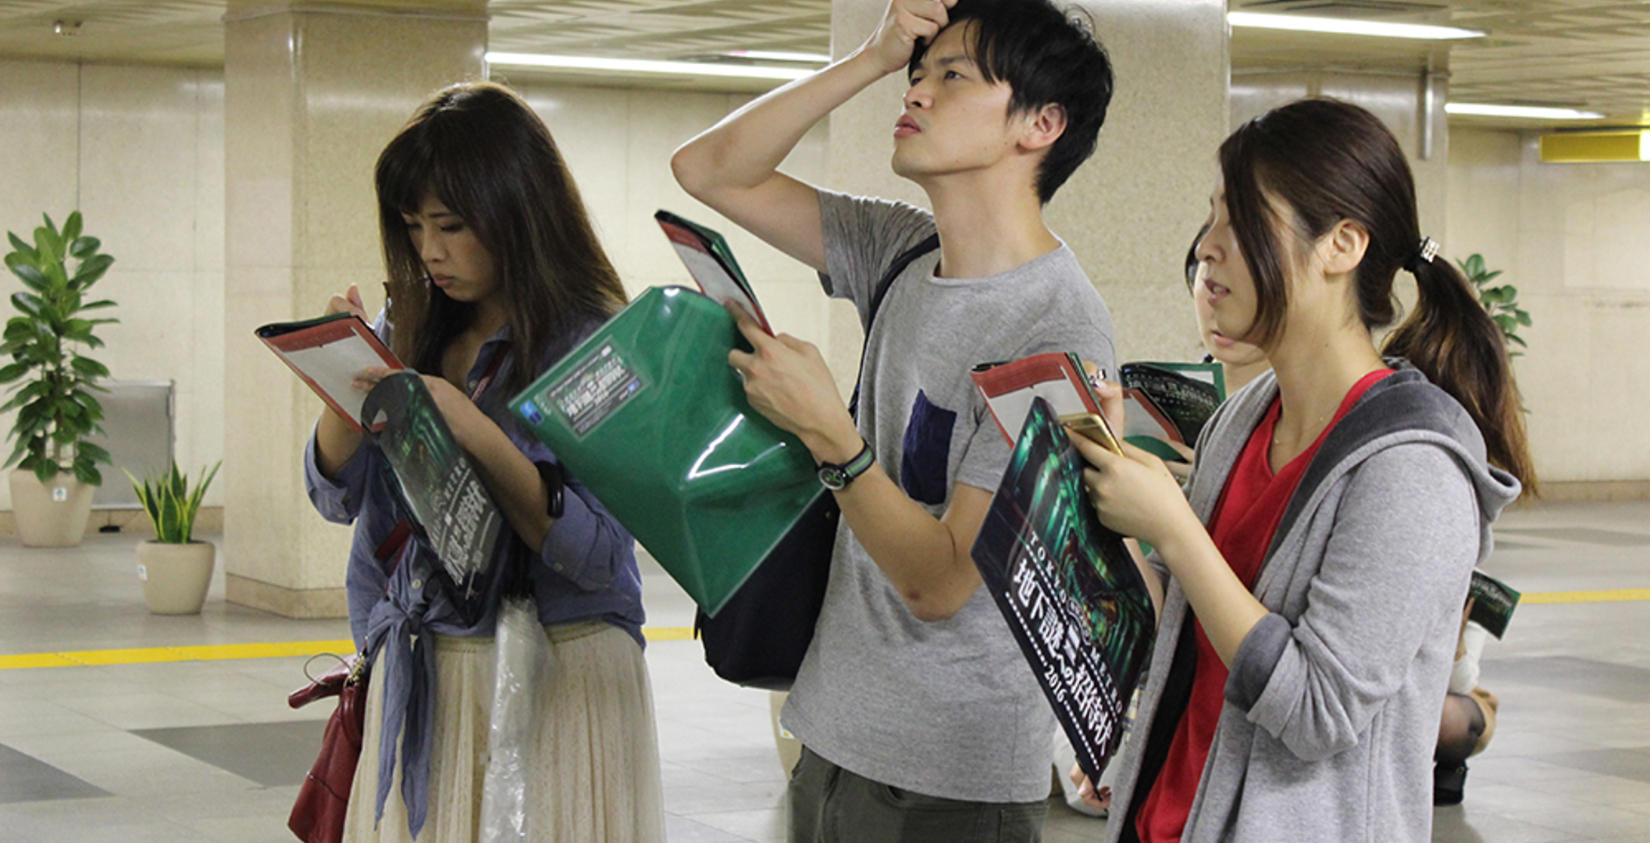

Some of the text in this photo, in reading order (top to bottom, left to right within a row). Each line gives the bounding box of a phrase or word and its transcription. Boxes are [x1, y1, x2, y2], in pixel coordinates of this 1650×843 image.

[1013, 557, 1113, 757] 地下謎への招待状
[1030, 530, 1123, 714] TOKYO METRO
[1044, 664, 1067, 704] 2016
